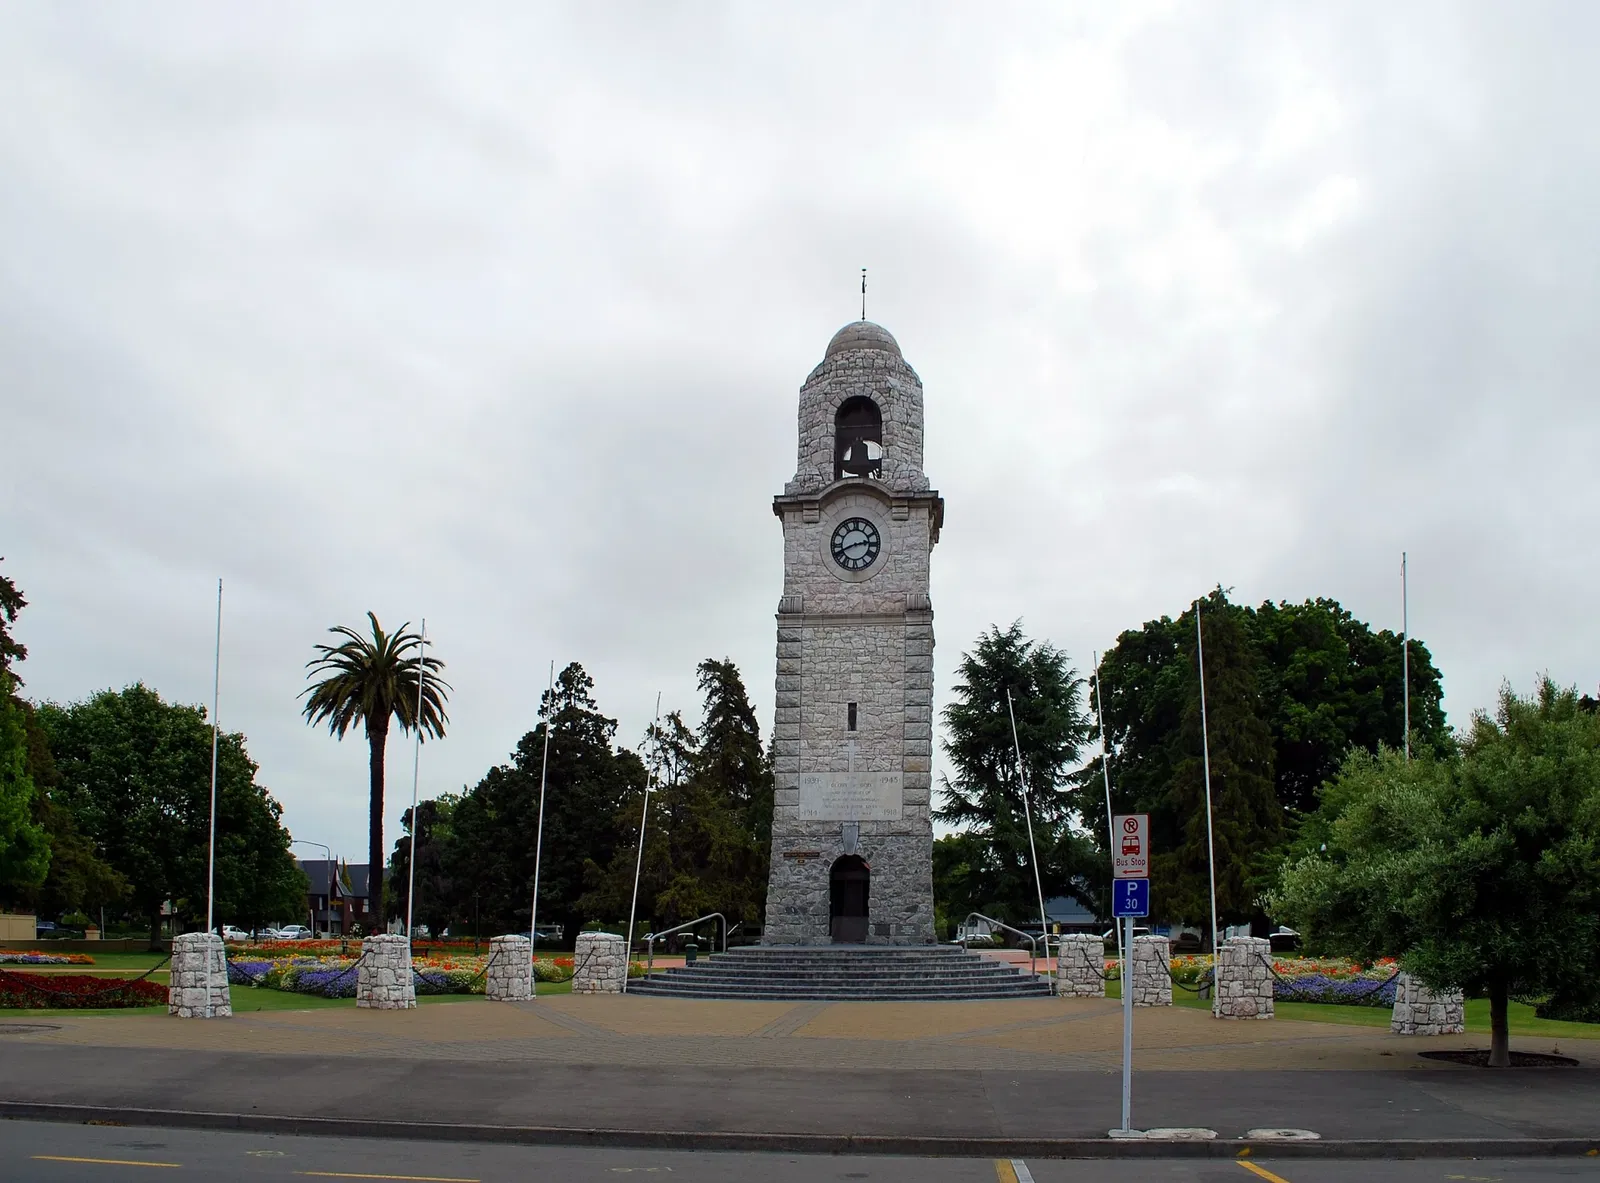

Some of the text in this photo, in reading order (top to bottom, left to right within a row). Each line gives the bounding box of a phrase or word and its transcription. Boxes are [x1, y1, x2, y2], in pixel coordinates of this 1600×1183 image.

[1116, 857, 1146, 867] Bus Stop
[1127, 881, 1138, 896] P
[1125, 898, 1138, 909] 30
